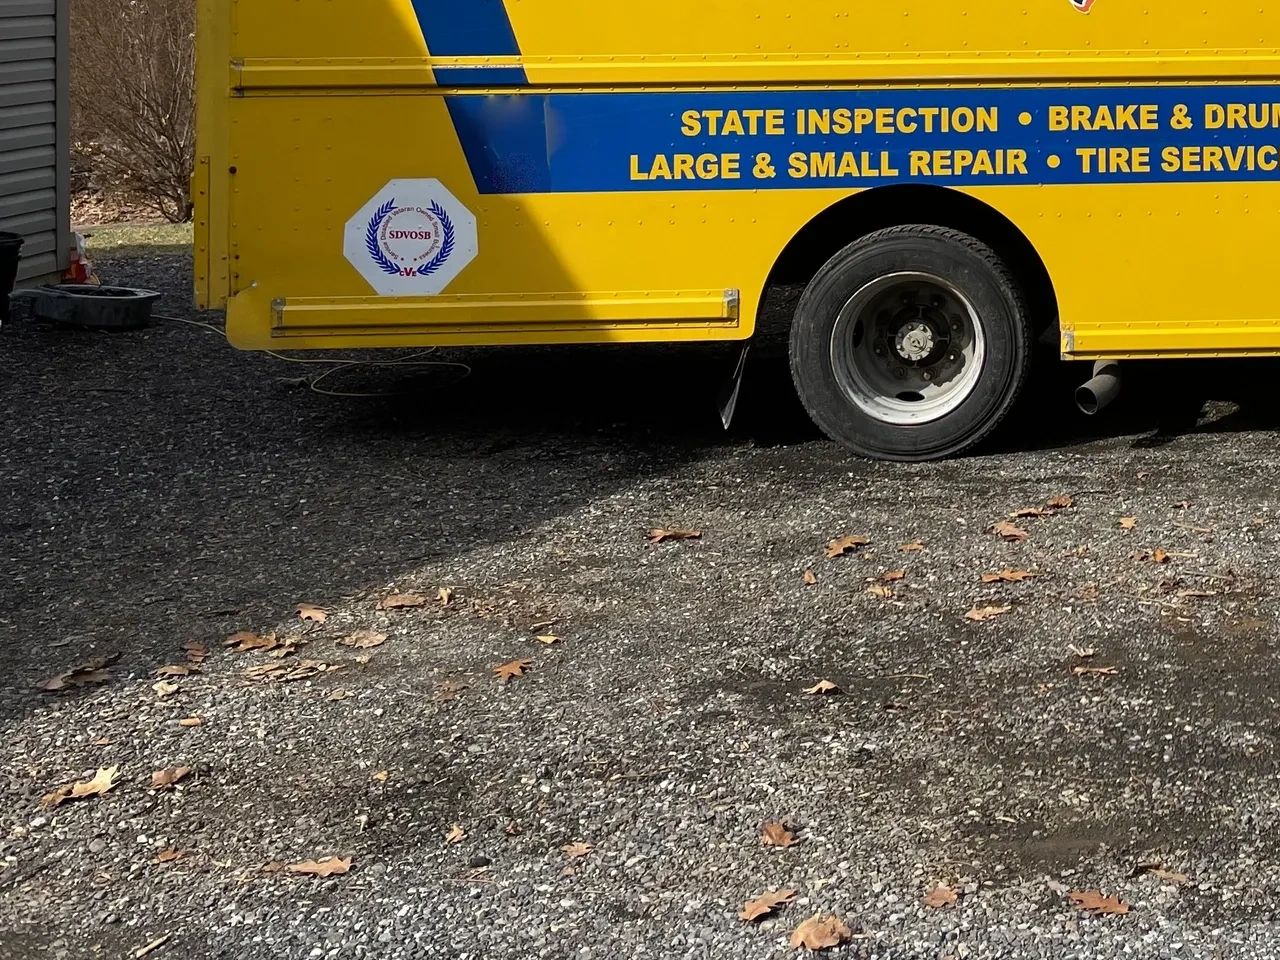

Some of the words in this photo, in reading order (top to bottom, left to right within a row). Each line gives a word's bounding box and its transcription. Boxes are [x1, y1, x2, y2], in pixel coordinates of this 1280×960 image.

[681, 109, 786, 137] STATE
[796, 106, 999, 135] INSPECTION
[1048, 104, 1159, 131] BRAKE
[1169, 103, 1193, 130] &
[629, 153, 741, 180] LARGE
[752, 152, 776, 179] &
[788, 151, 899, 178] SMALL
[909, 148, 1028, 176] REPAIR
[1075, 147, 1151, 173] TIRE
[389, 230, 431, 240] SDVOSB
